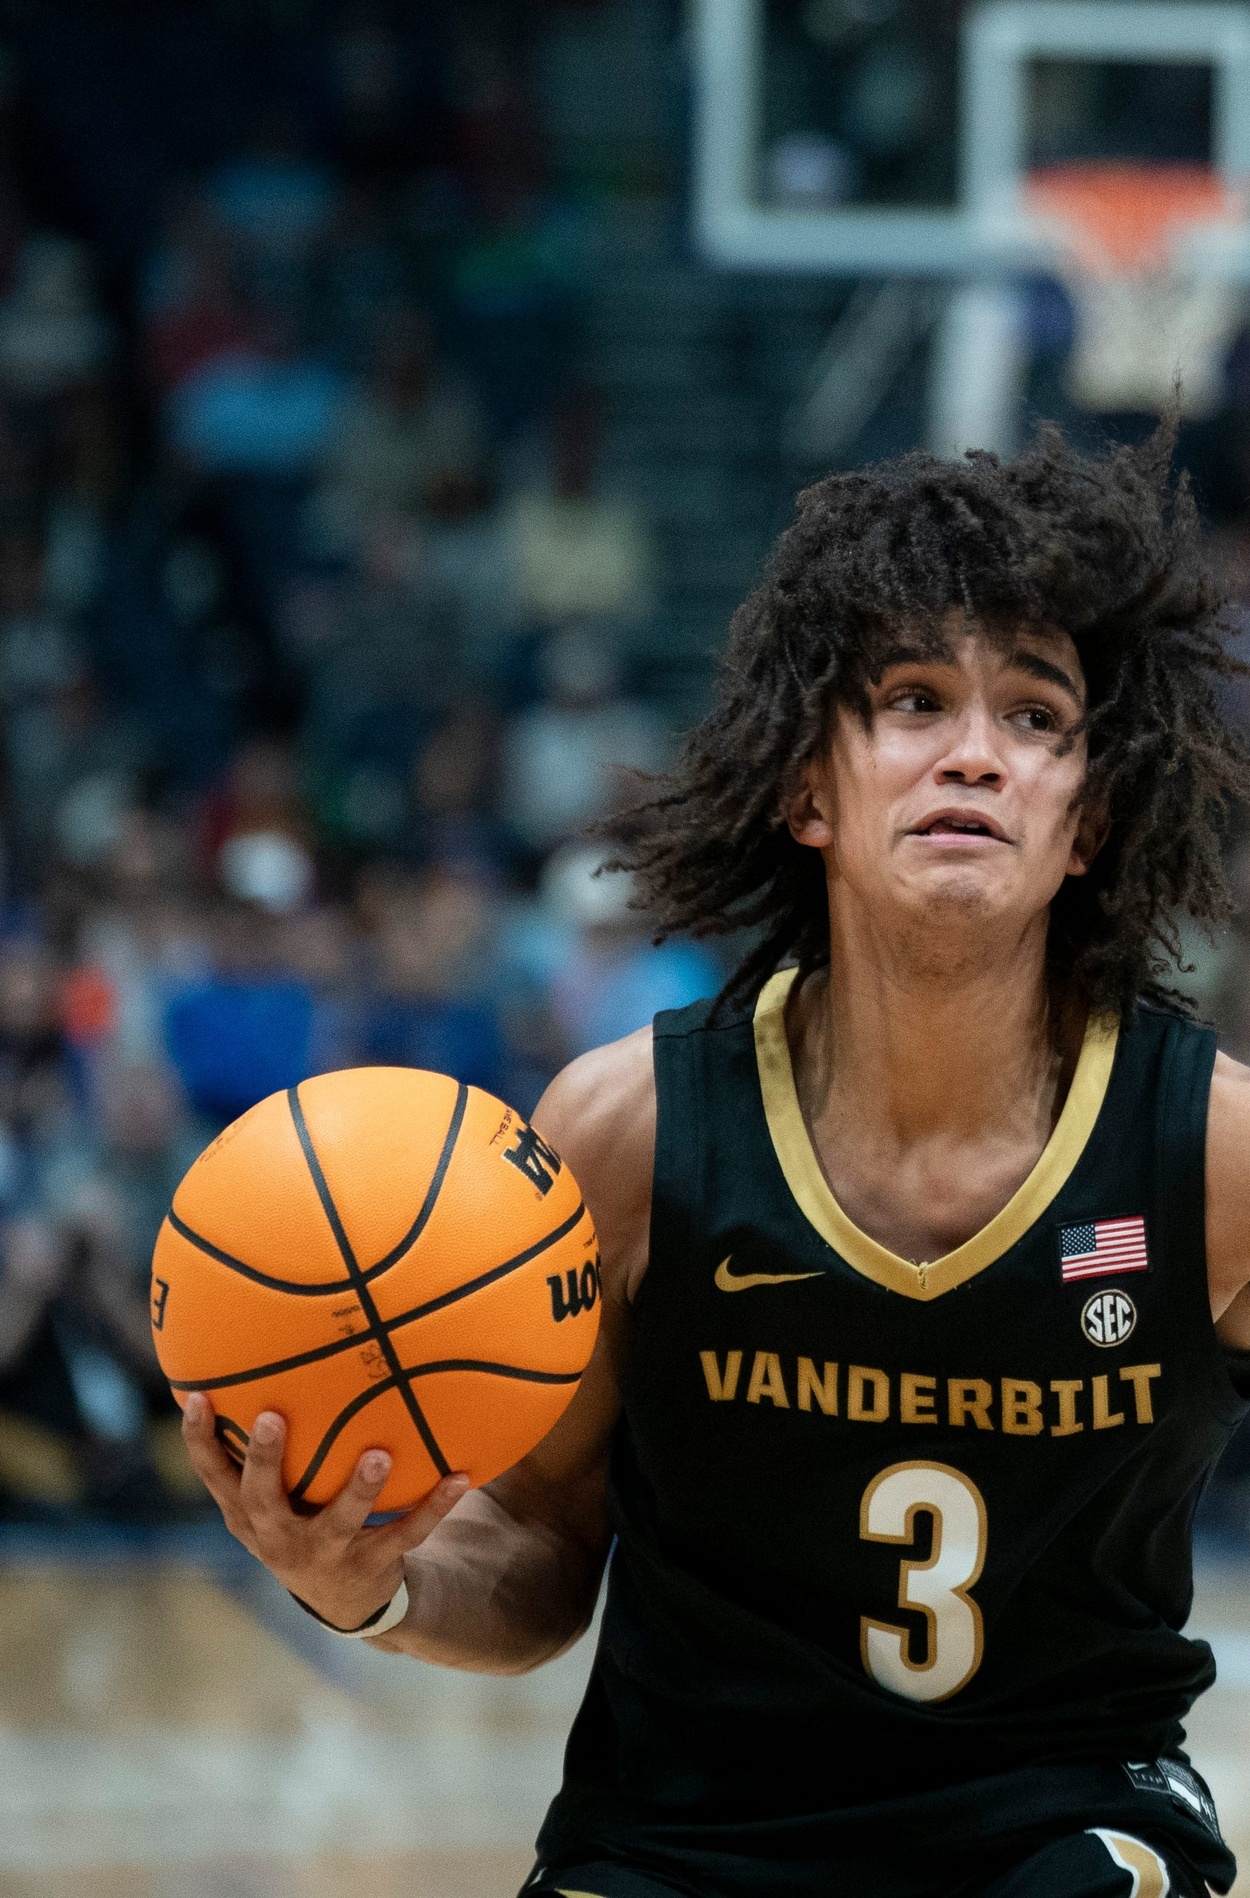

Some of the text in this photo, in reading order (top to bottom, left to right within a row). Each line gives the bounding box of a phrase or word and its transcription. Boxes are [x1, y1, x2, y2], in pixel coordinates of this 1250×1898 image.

[489, 1121, 509, 1146] BALL
[1086, 1295, 1131, 1342] SEC
[700, 1350, 1161, 1437] VANDERBILT
[859, 1460, 988, 1703] 3
